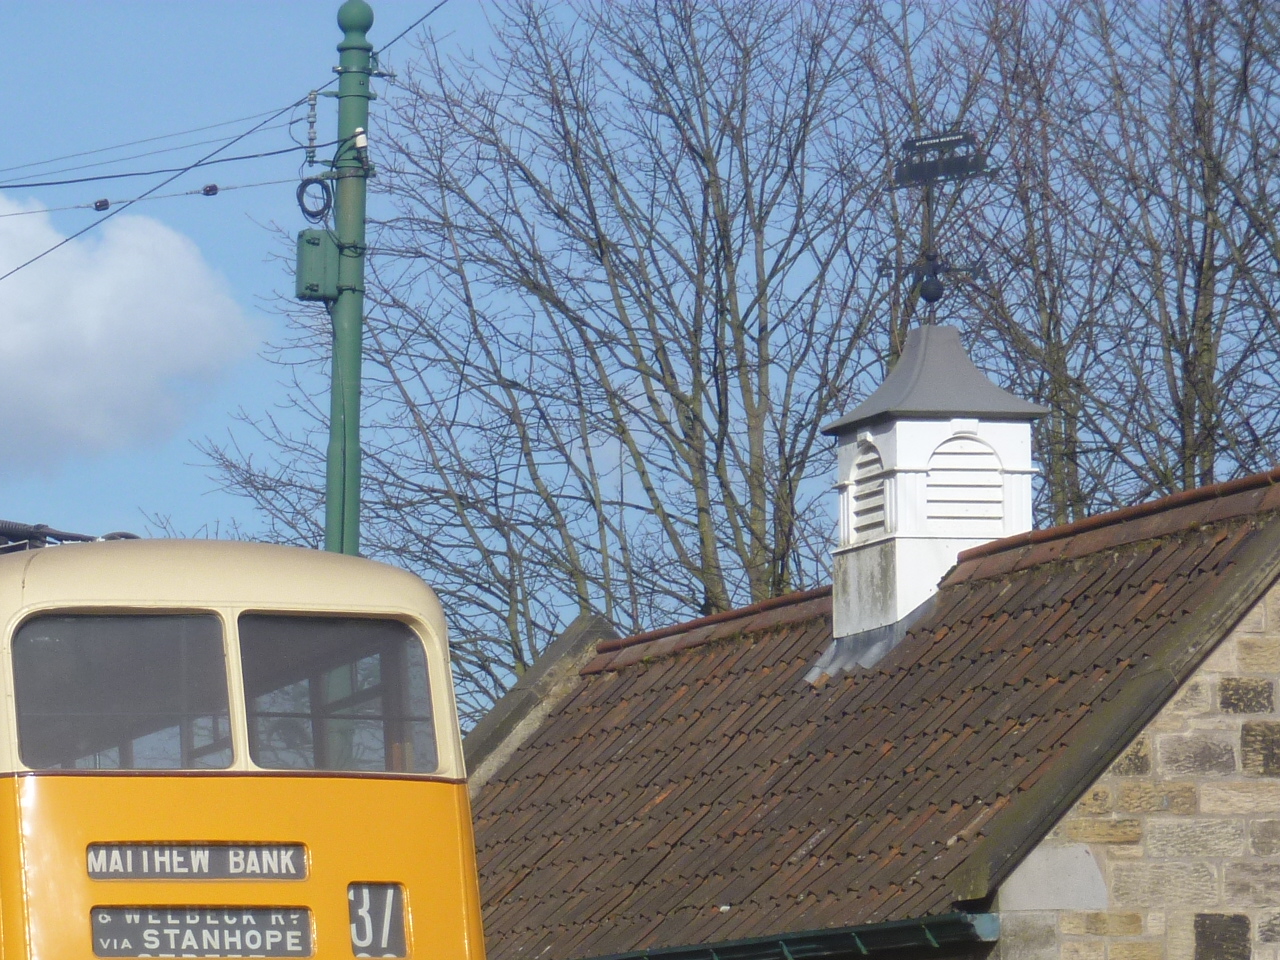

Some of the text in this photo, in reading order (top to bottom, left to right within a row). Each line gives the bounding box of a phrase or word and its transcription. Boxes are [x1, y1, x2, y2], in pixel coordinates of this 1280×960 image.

[229, 848, 296, 874] BANK
[100, 929, 302, 951] VIA STANHOPE
